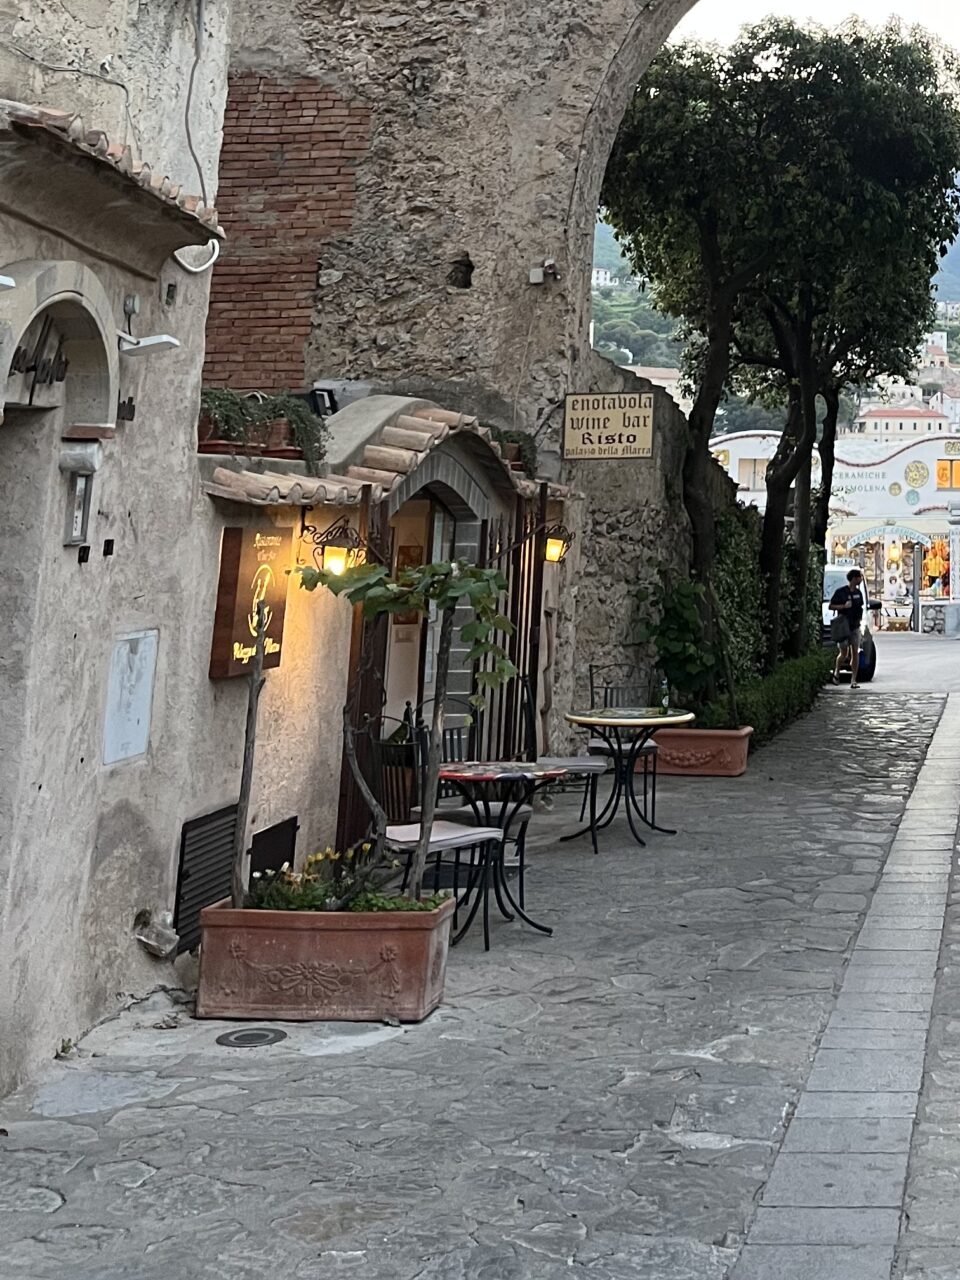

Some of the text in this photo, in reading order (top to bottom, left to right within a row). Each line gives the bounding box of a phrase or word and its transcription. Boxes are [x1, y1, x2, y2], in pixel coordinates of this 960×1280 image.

[570, 412, 650, 430] wine bar
[582, 432, 637, 445] Risto
[832, 471, 887, 479] CERAMICHE
[831, 485, 886, 493] COSMOLENA
